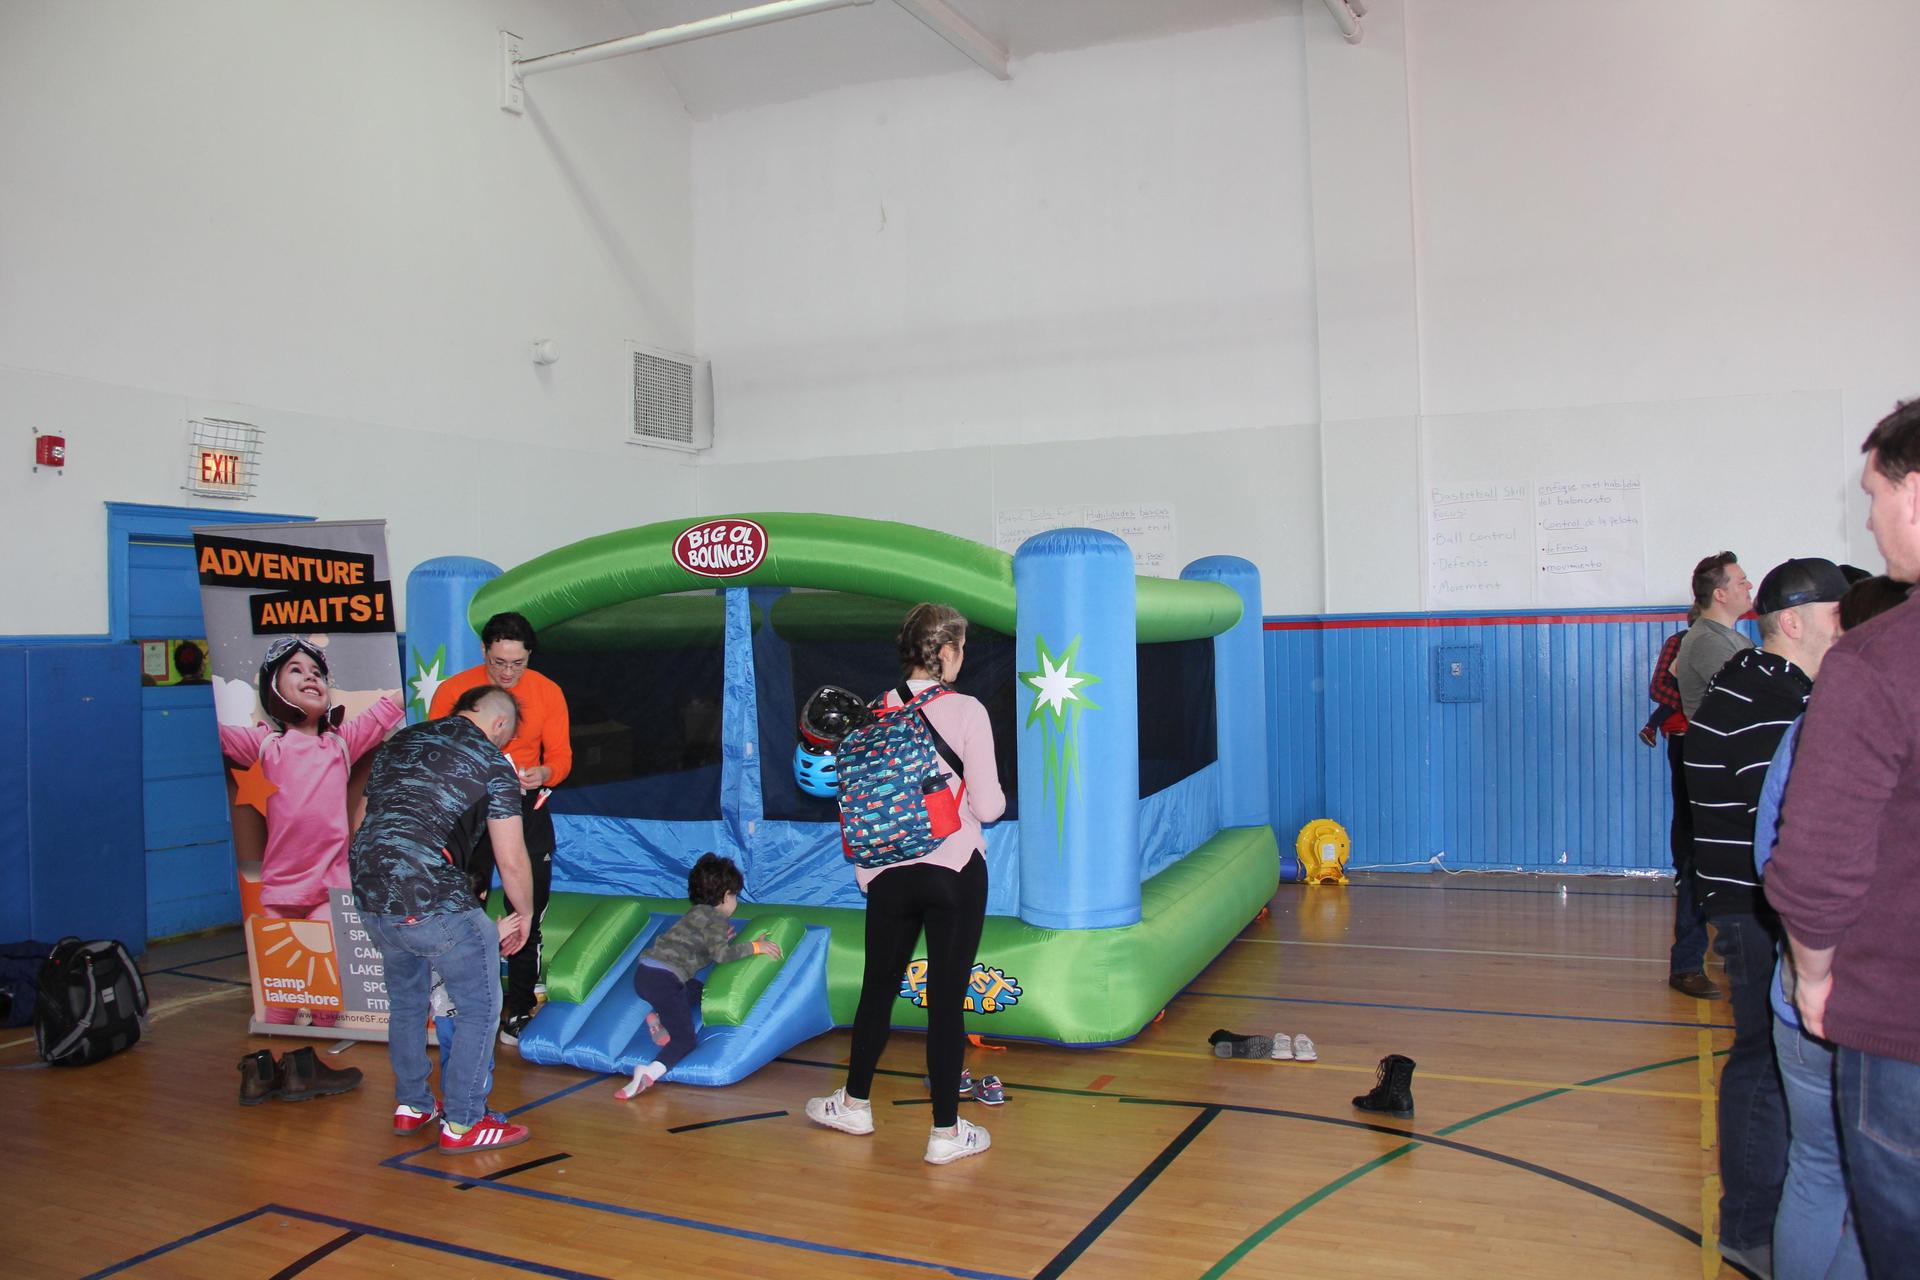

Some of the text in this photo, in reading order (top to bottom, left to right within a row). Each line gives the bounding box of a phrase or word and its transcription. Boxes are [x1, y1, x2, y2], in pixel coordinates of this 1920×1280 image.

[201, 452, 239, 485] EXIT
[199, 546, 365, 586] ADVENTURE
[688, 544, 754, 568] BOUNCER
[260, 593, 385, 626] AWAITS!
[349, 963, 384, 976] LAKE
[263, 977, 306, 991] camp
[265, 990, 340, 1007] lakeshore
